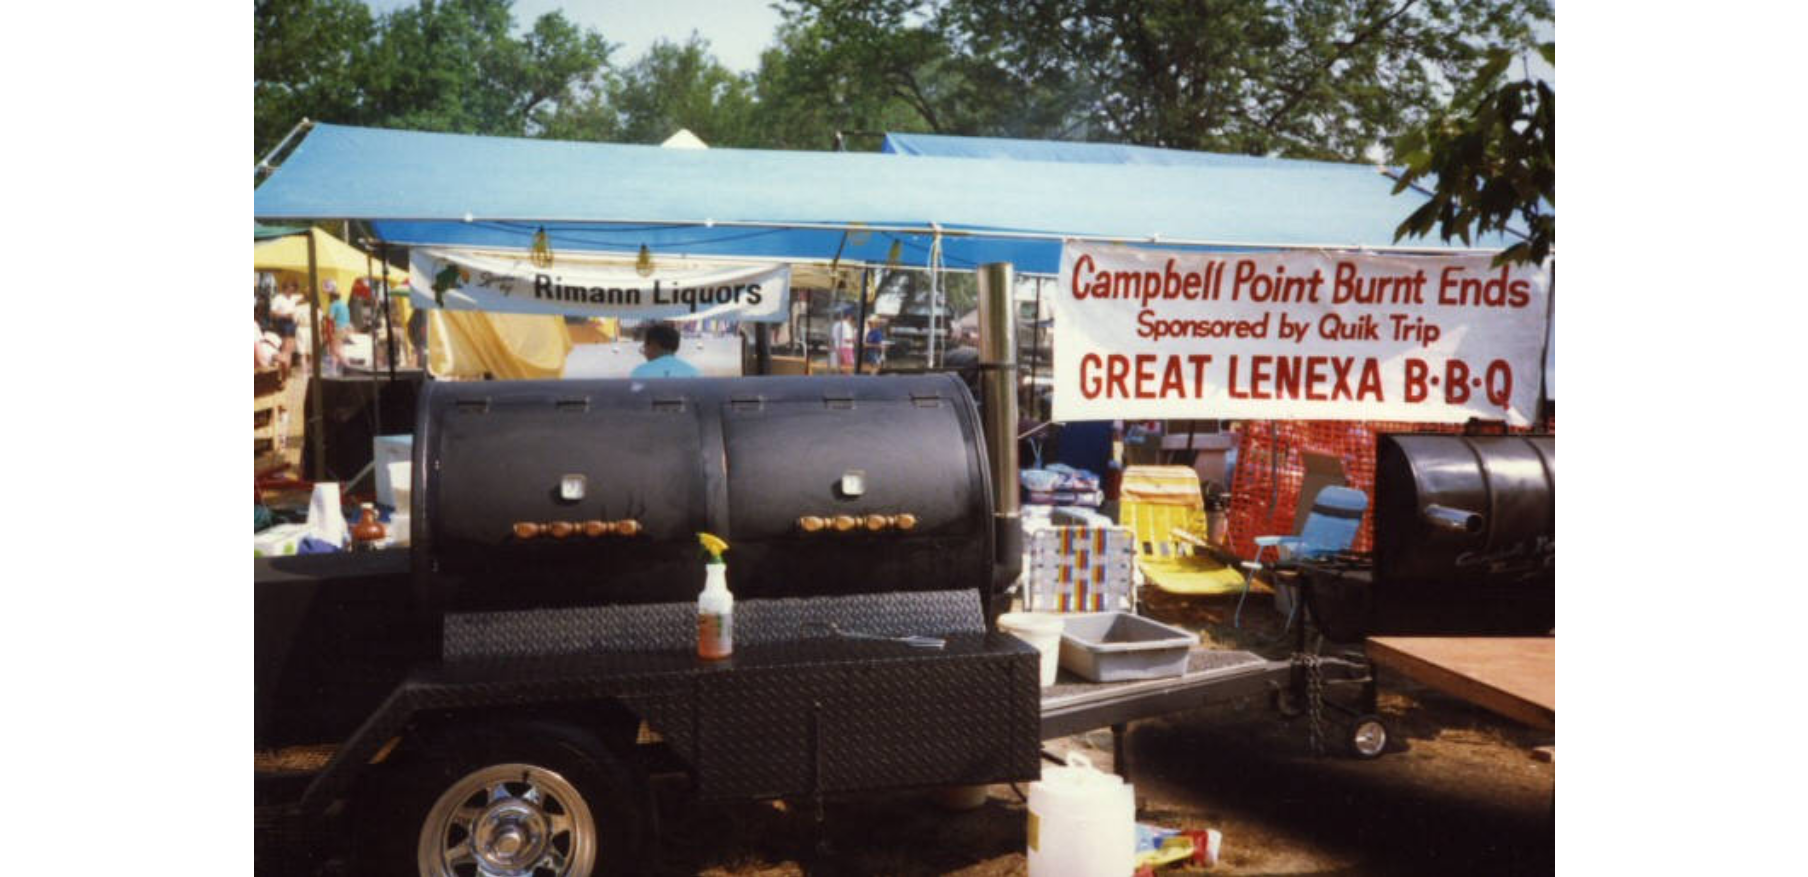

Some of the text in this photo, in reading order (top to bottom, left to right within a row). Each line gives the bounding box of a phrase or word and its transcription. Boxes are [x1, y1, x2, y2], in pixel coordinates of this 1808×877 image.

[534, 274, 641, 305] Rimann
[653, 280, 762, 314] Liquors
[1071, 254, 1531, 308] Campbell Point Burnt Ends
[1136, 309, 1441, 348] Sponsored by Quik Trip
[1079, 353, 1212, 400] GREAT
[1228, 354, 1384, 402] LENEXA
